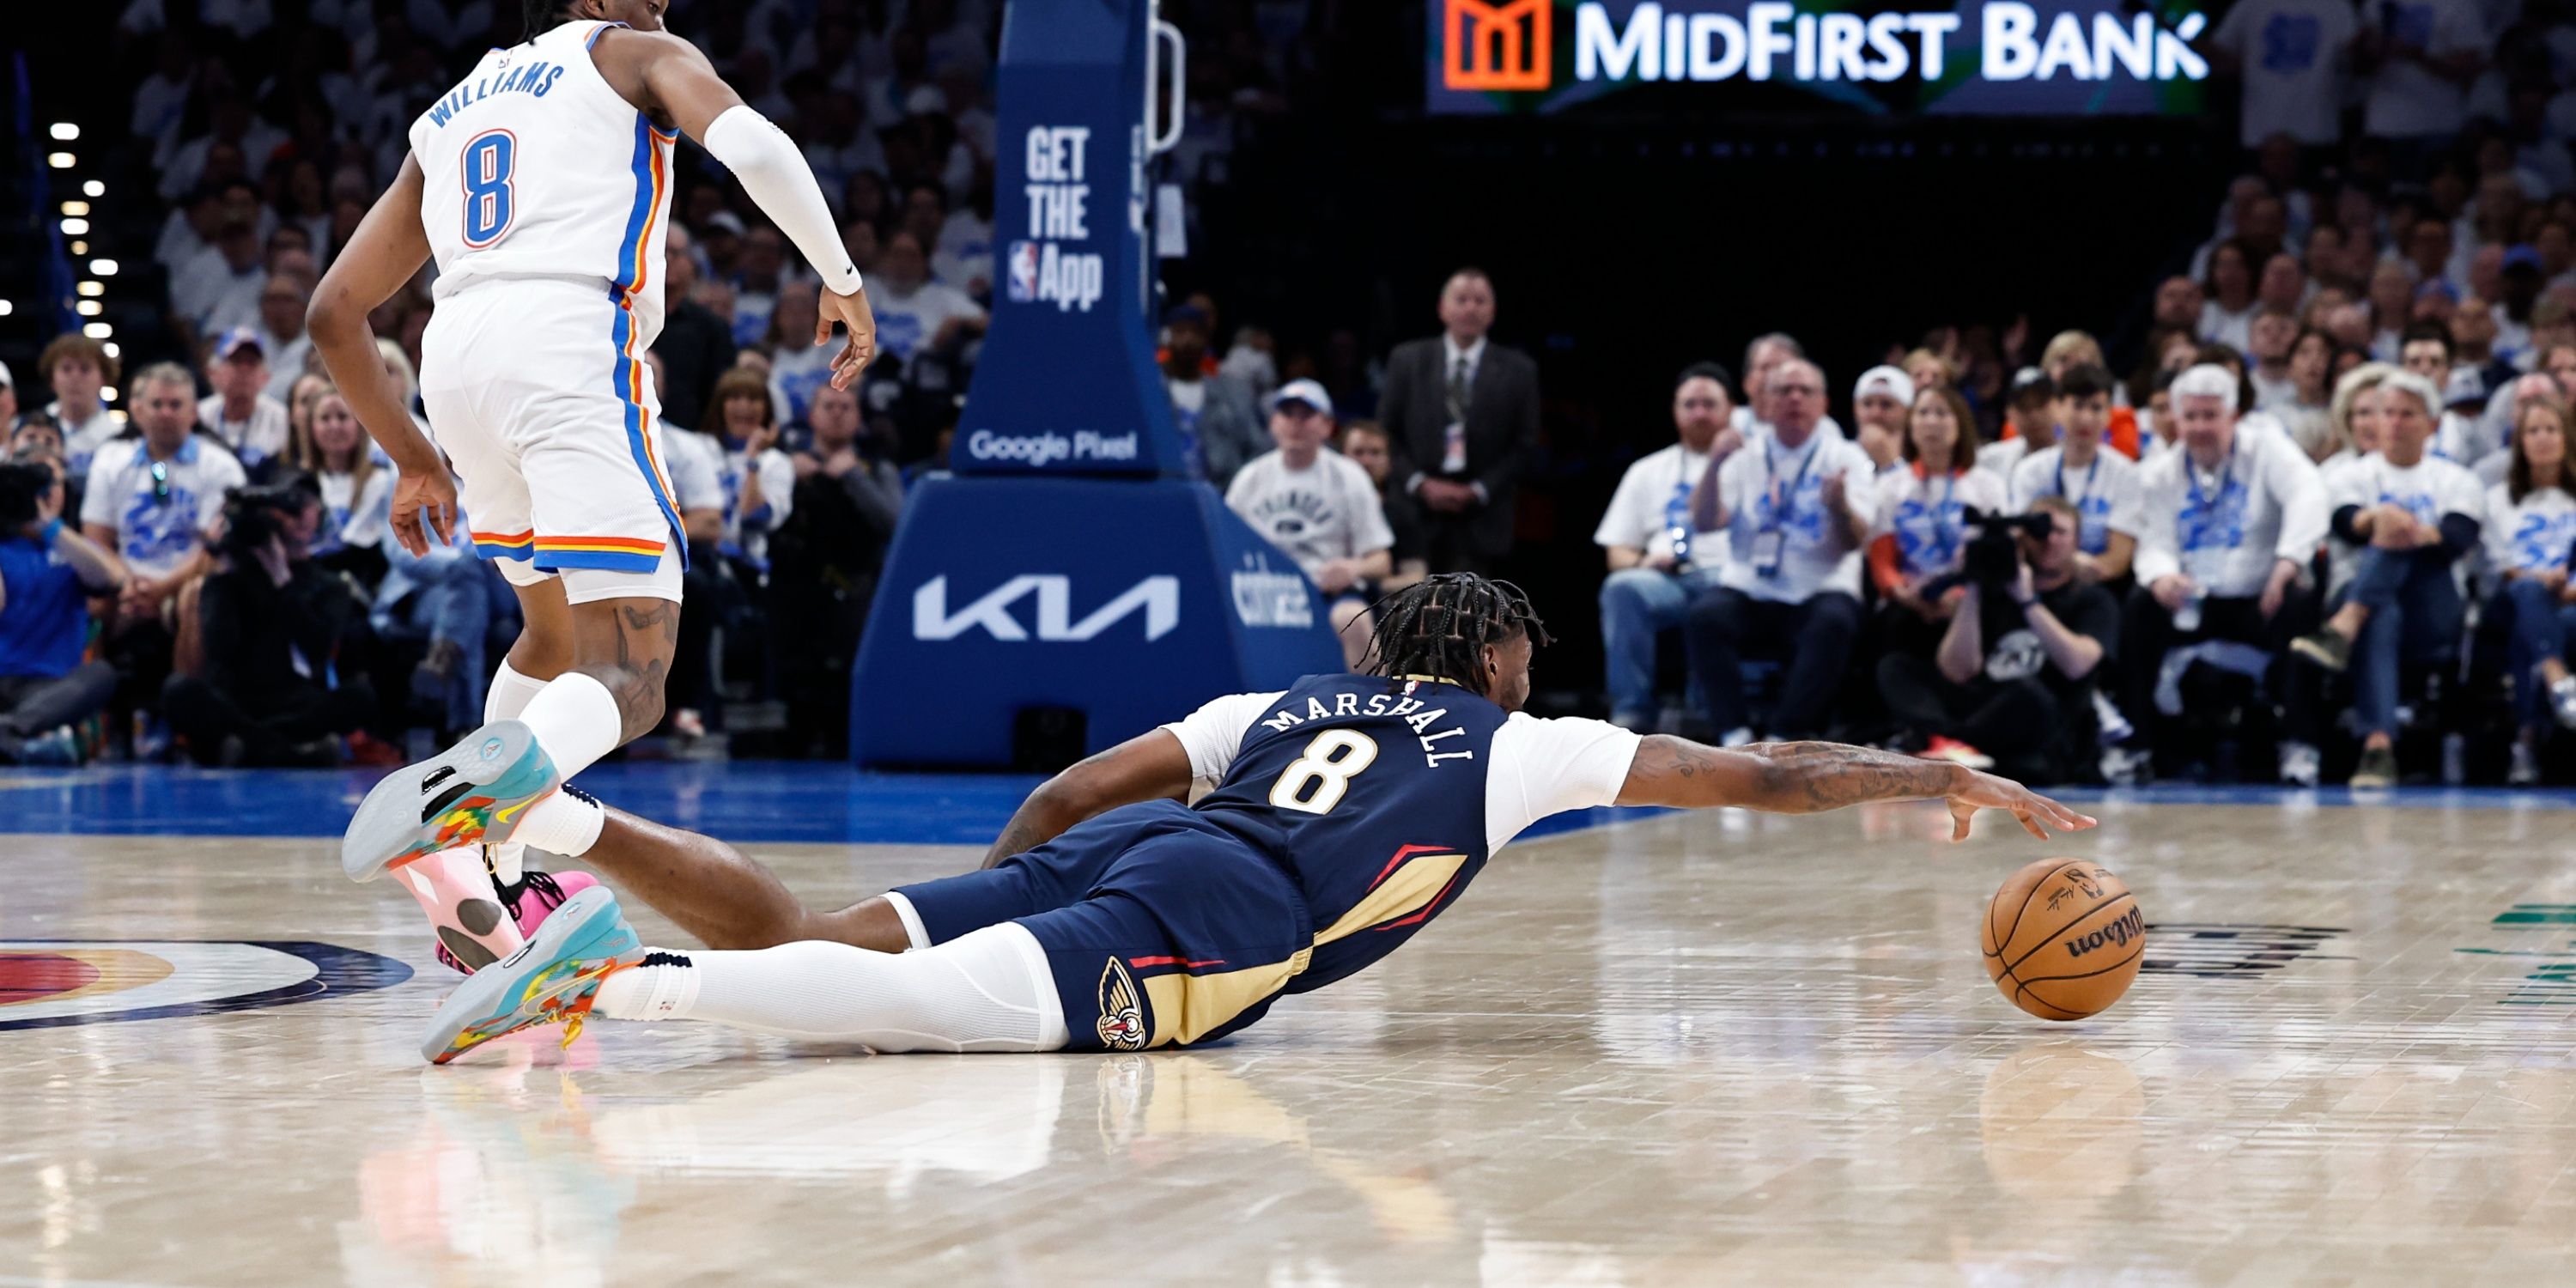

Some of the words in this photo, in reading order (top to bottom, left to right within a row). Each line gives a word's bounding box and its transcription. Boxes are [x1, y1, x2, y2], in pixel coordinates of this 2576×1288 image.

[428, 62, 564, 128] WILLIAMS
[1026, 126, 1090, 181] GET
[460, 128, 517, 248] 8
[1025, 185, 1090, 240] THE
[1038, 242, 1103, 313] App
[969, 429, 1071, 467] Google
[1261, 693, 1473, 769] MARSHALL
[1268, 728, 1378, 815] 8
[2065, 904, 2145, 957] Wilson
